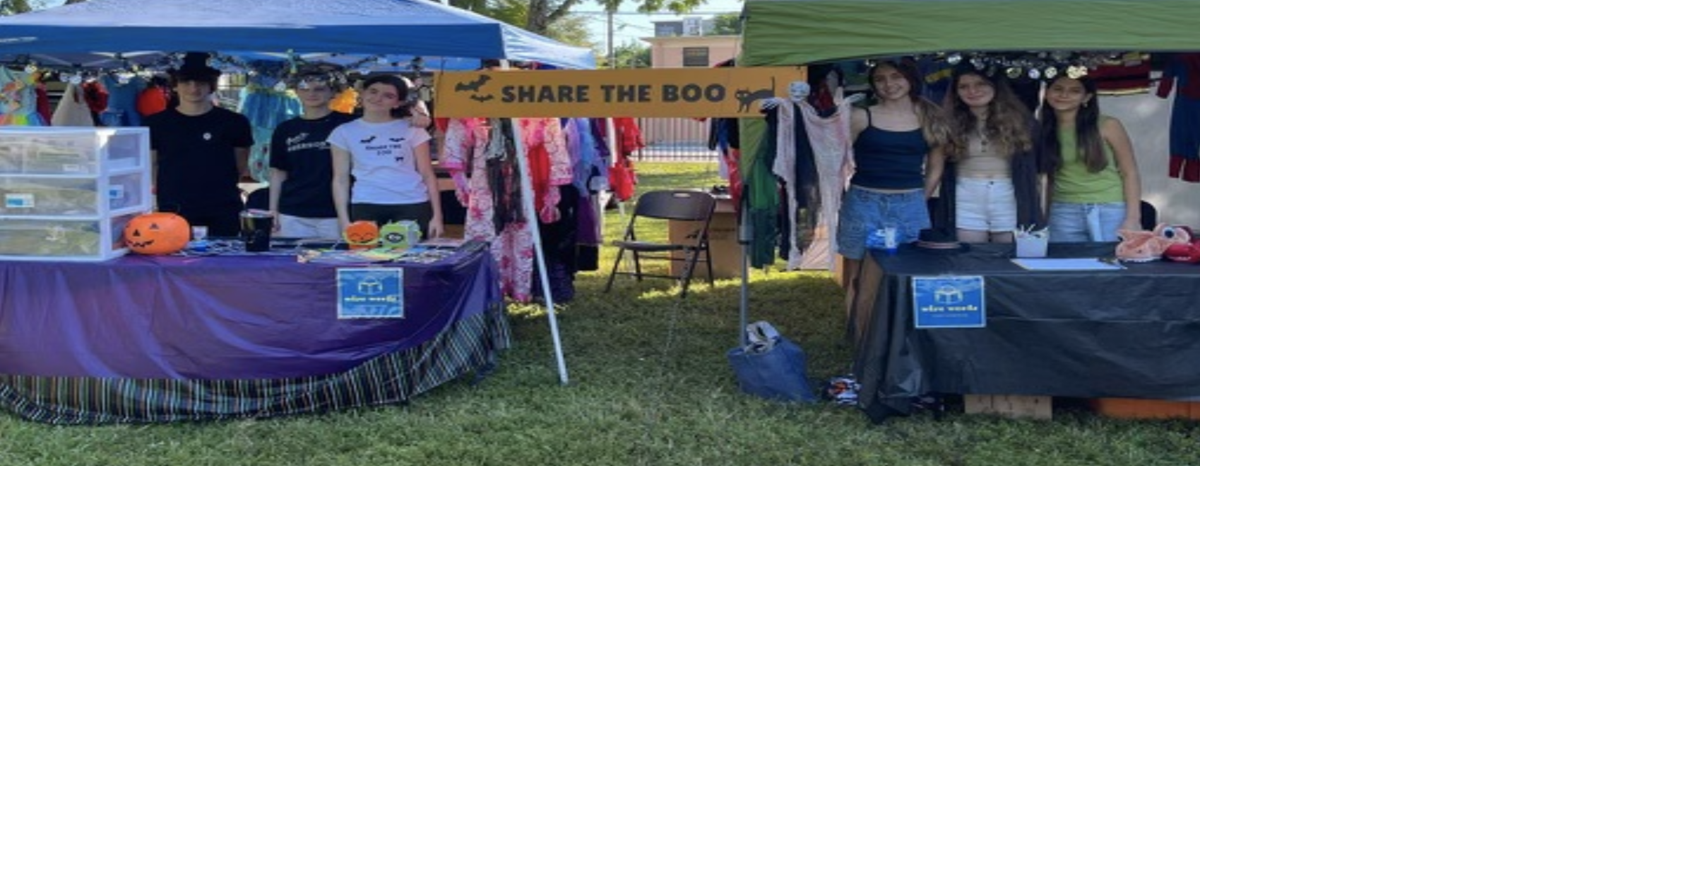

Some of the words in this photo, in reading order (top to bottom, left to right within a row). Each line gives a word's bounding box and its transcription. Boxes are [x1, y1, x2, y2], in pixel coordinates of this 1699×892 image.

[501, 84, 590, 103] SHARE
[600, 84, 652, 103] THE
[661, 83, 726, 103] BOO
